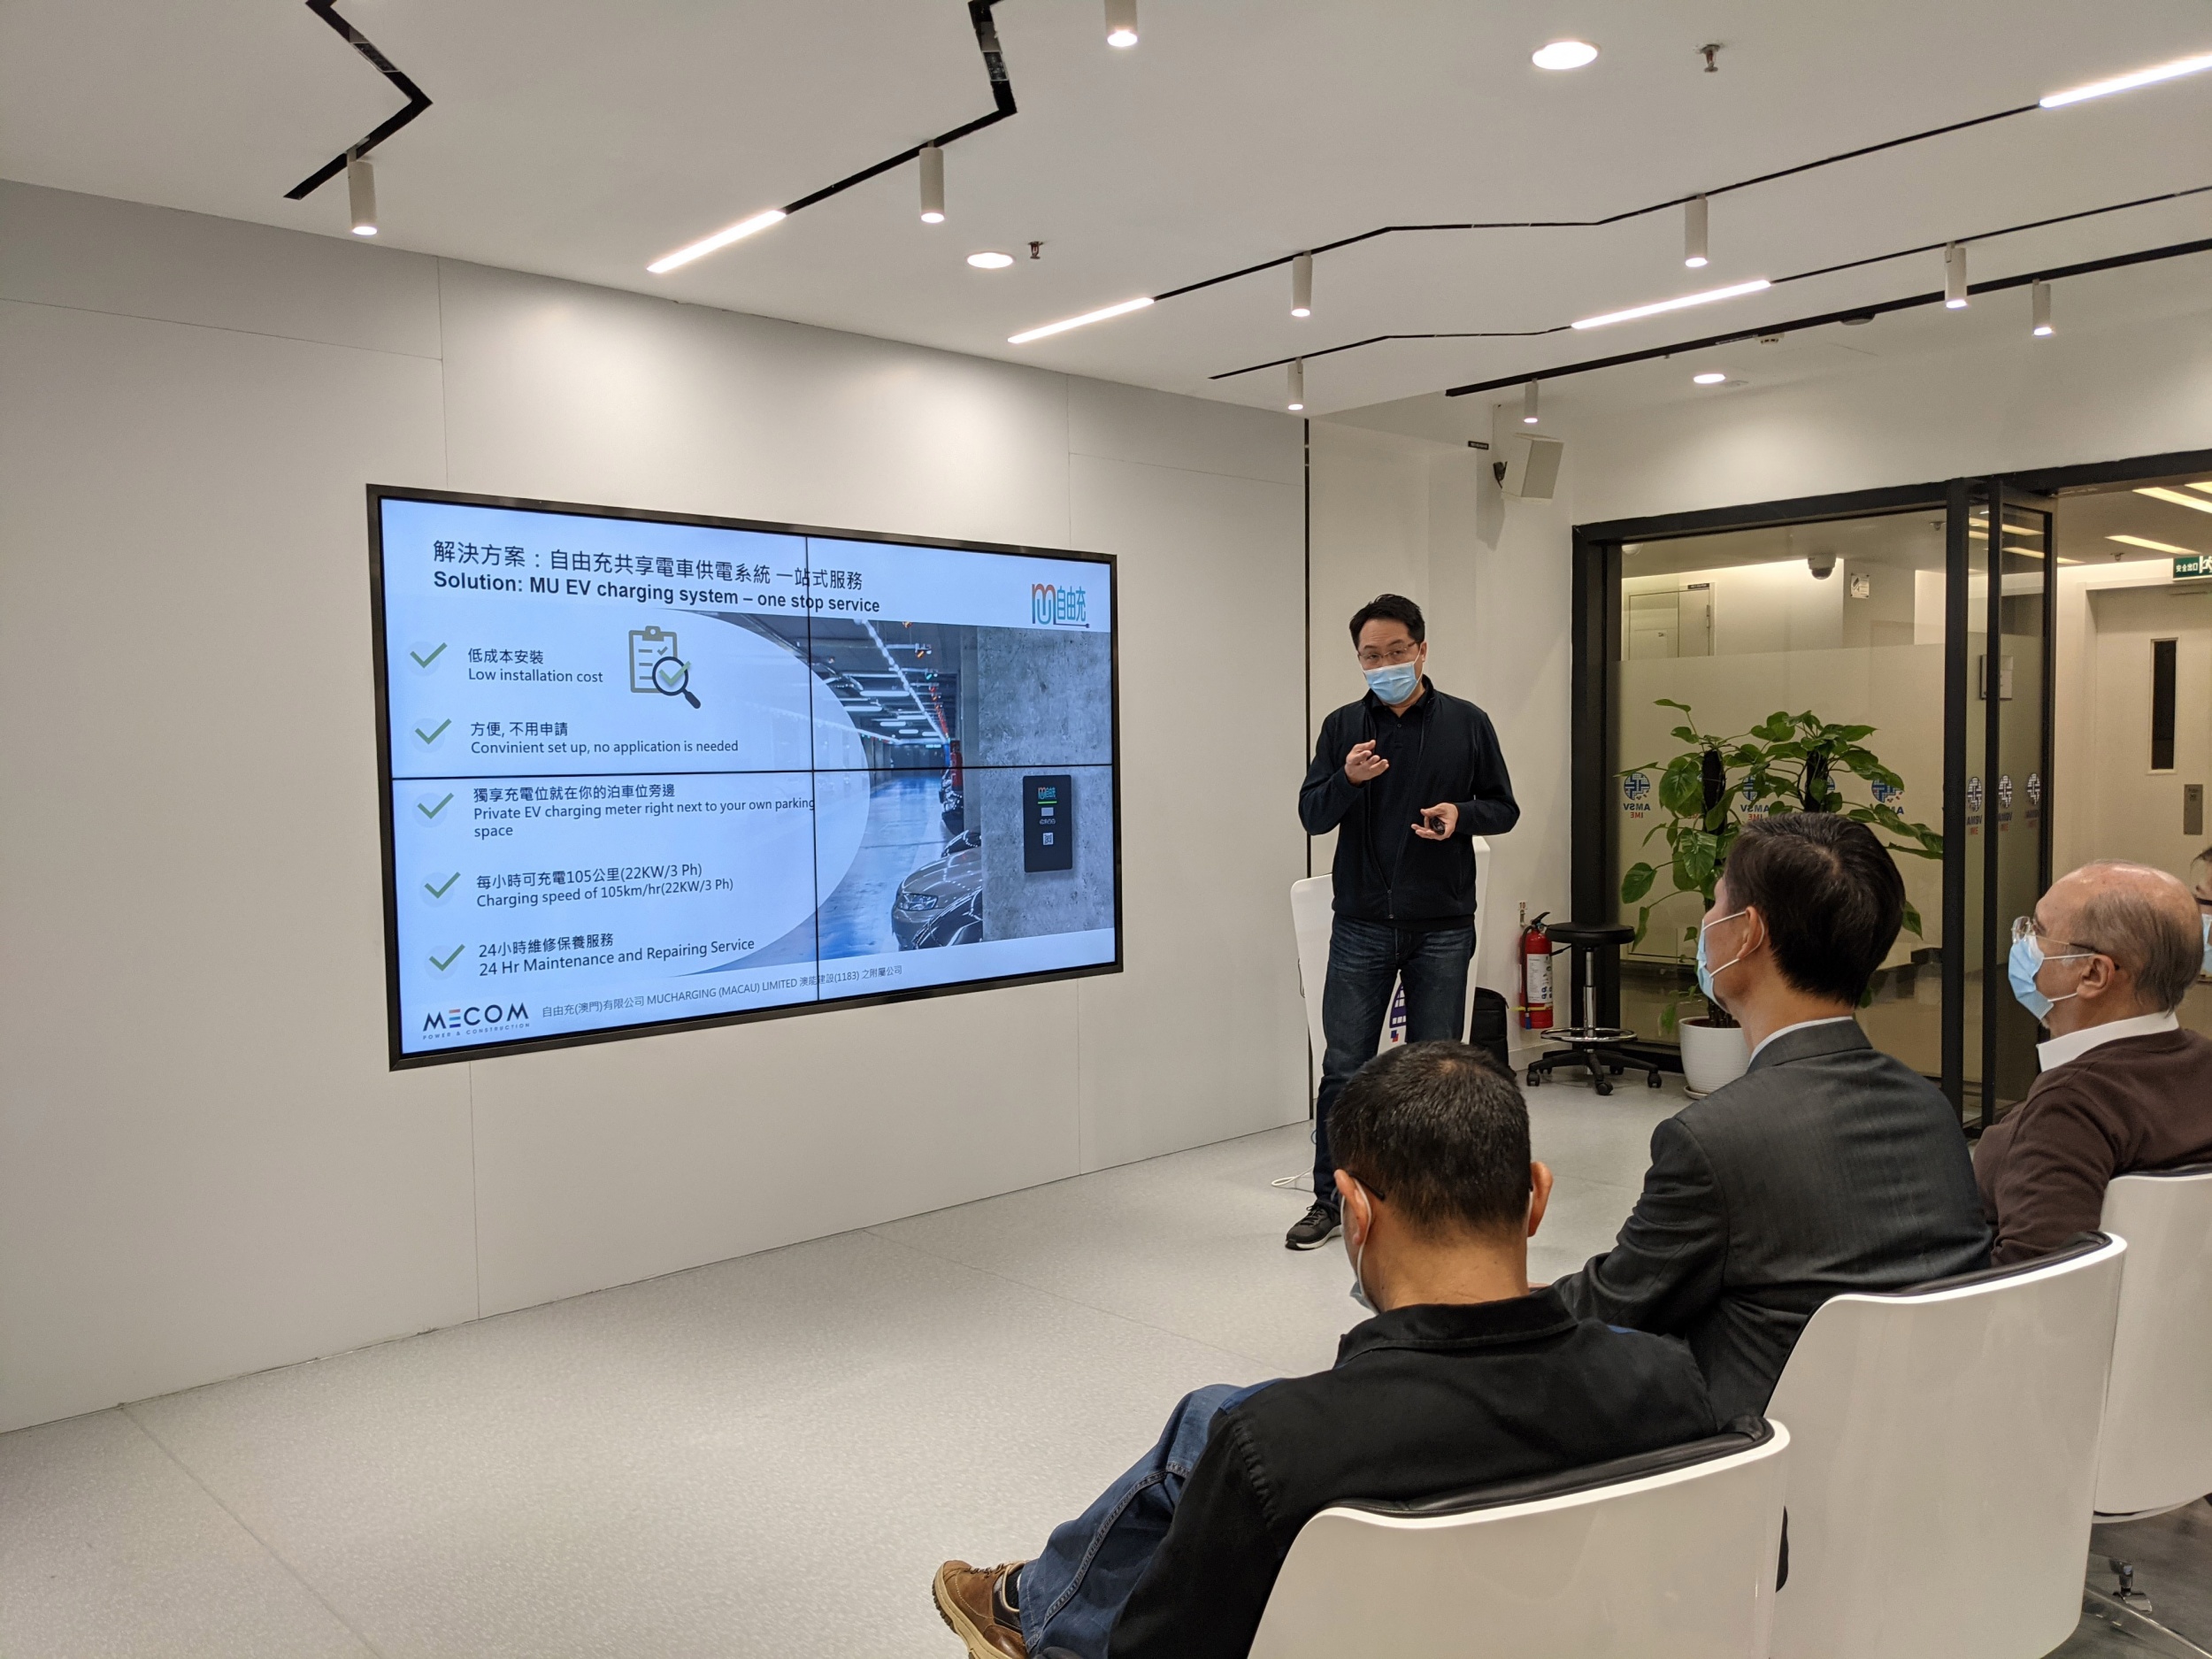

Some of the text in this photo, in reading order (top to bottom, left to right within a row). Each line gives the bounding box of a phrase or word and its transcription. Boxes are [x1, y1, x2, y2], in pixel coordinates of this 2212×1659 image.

[2176, 562, 2199, 573] 安全出口
[434, 571, 523, 593] Solution:
[530, 577, 559, 595] MU
[566, 580, 592, 596] EV
[596, 581, 674, 605] charging
[680, 588, 739, 606] system
[757, 594, 787, 608] one
[791, 596, 824, 612] stop
[828, 597, 880, 613] service
[1056, 585, 1087, 622] 自由充
[468, 648, 544, 664] 低成本安裝
[468, 668, 603, 683] Low installation cost
[509, 722, 568, 737] 不用申請
[471, 740, 739, 756] Convinient set up, no application is needed
[473, 783, 675, 803] 獨享充電位就在你的泊車位旁邊
[473, 797, 815, 820] Private EV charging meter right next to your own parking
[474, 826, 513, 841] space
[681, 863, 703, 878] Ph)
[477, 878, 733, 909] Charging speed of 105km/hr(22KW/3 Ph)
[479, 933, 614, 958] 24小時維修保養服務
[480, 939, 755, 977] 24 Hr Maintenance and Repairing Service
[542, 995, 644, 1018] 自由充(澳門)有限公司
[647, 987, 717, 1006] MUCHARGING
[718, 982, 760, 998] (MACAU)
[762, 978, 797, 992] LIMITED
[423, 1002, 529, 1033] MECOM
[423, 1032, 451, 1041] POWER
[466, 1023, 530, 1035] CONSTRUCTION
